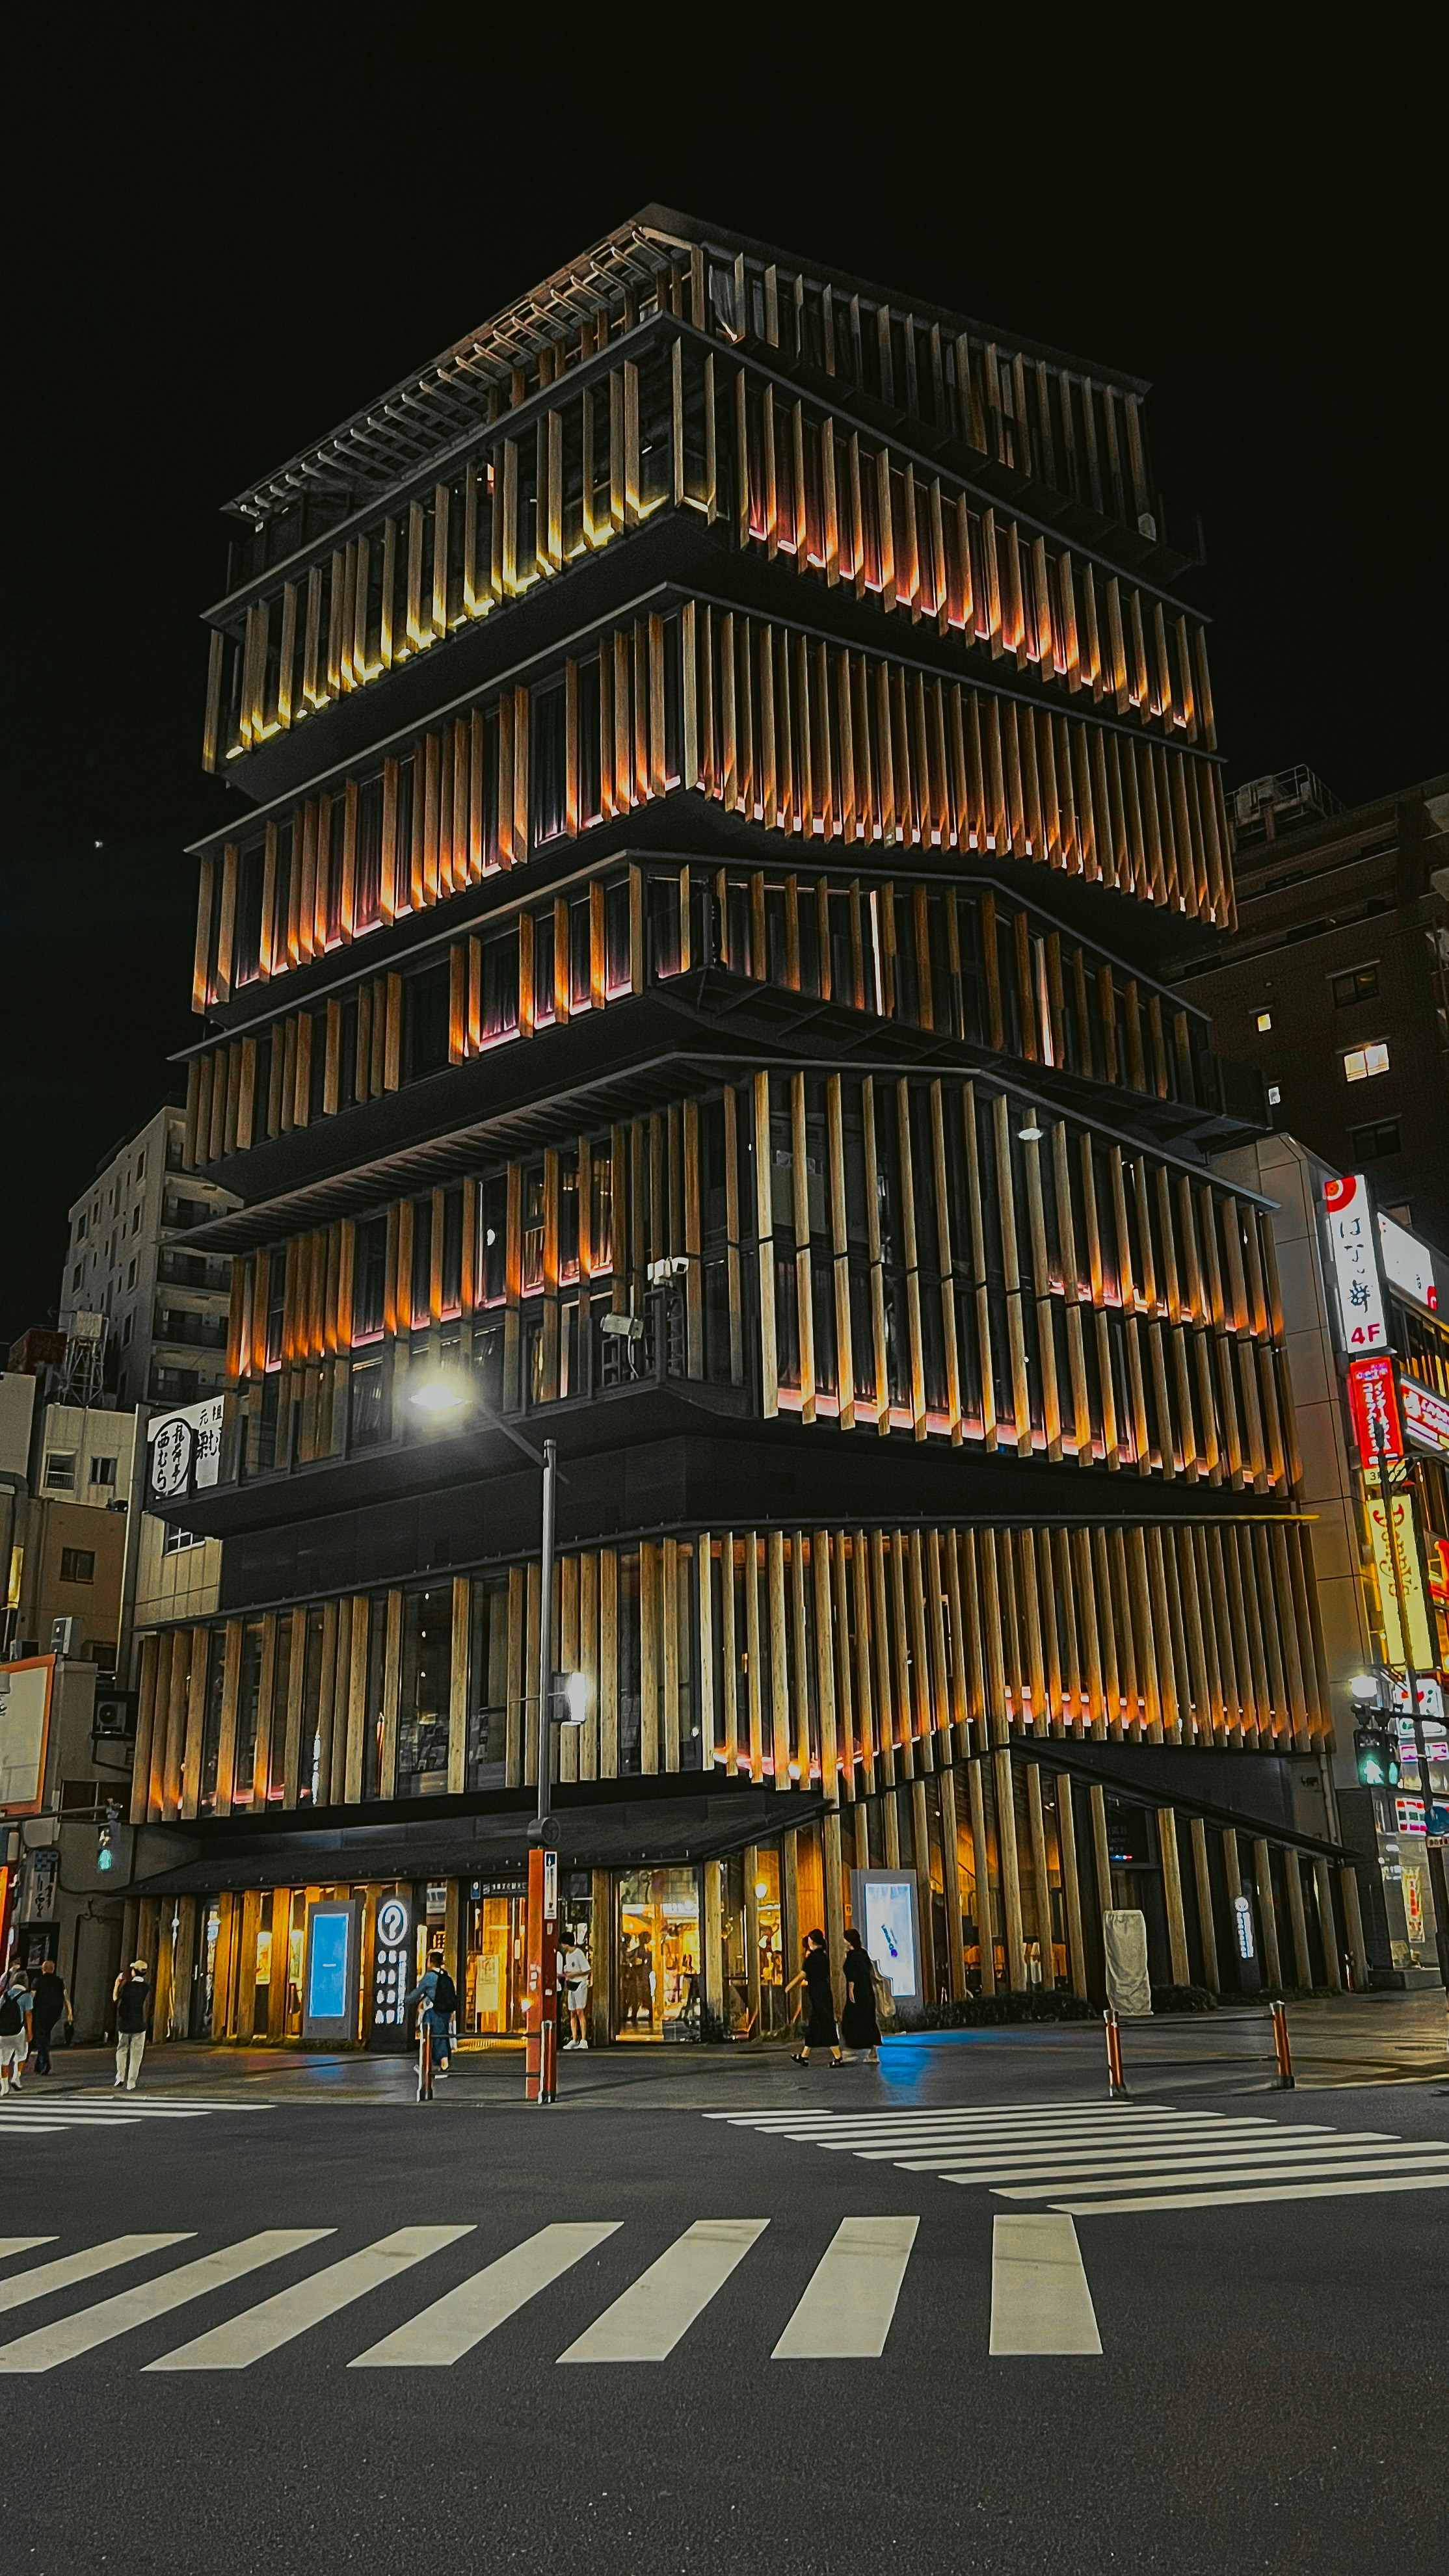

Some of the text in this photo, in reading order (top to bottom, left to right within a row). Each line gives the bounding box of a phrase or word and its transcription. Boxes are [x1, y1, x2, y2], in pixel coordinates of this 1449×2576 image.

[1351, 1322, 1380, 1345] 4F
[199, 1404, 222, 1426] 元祖
[157, 1430, 170, 1490] 西むら
